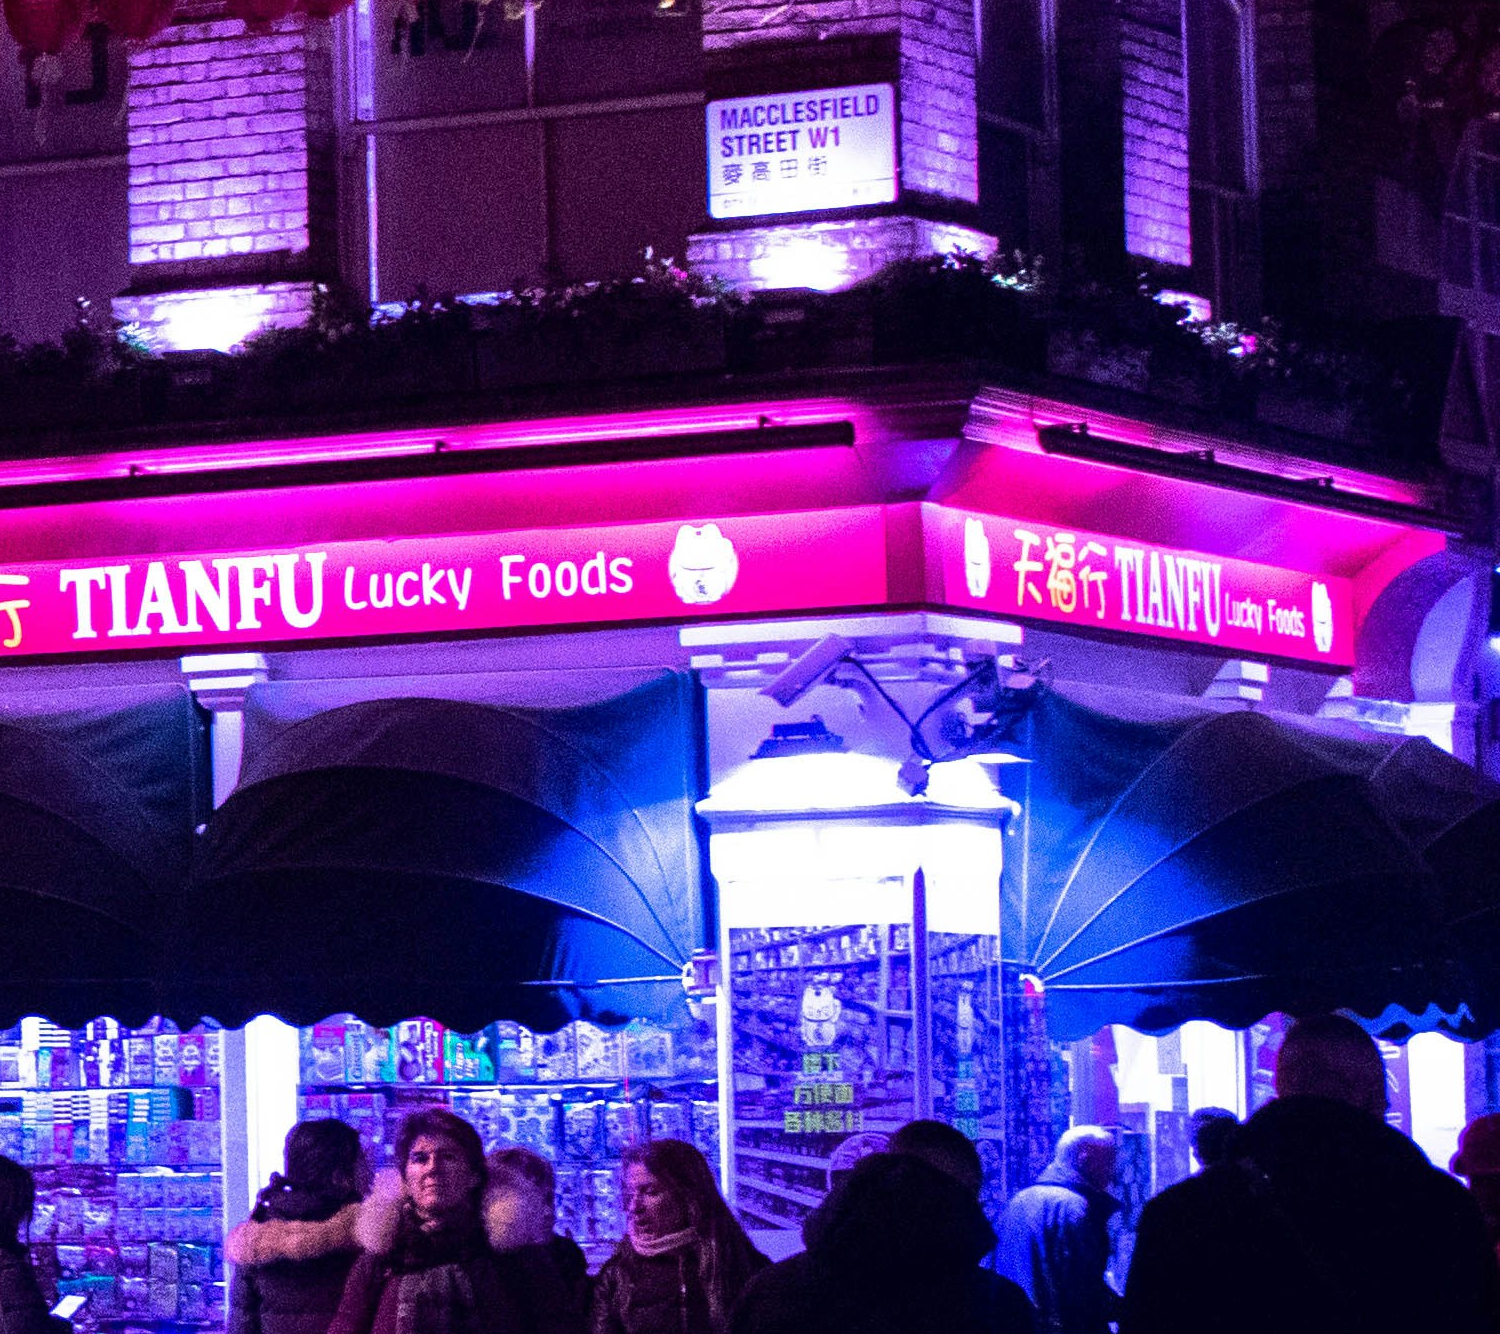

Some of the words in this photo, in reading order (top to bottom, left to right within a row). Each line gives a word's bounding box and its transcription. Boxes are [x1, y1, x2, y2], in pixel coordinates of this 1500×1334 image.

[719, 94, 879, 130] MACCLESFIELD
[720, 129, 799, 158] STREET
[807, 126, 840, 149] W1
[60, 552, 327, 641] TIANFU
[344, 564, 471, 611] Lucky
[501, 551, 633, 601] Foods
[1013, 529, 1107, 619] 天福行
[1114, 547, 1222, 637] TIANFU
[1225, 592, 1264, 635] Lucky
[1266, 599, 1305, 639] Foods
